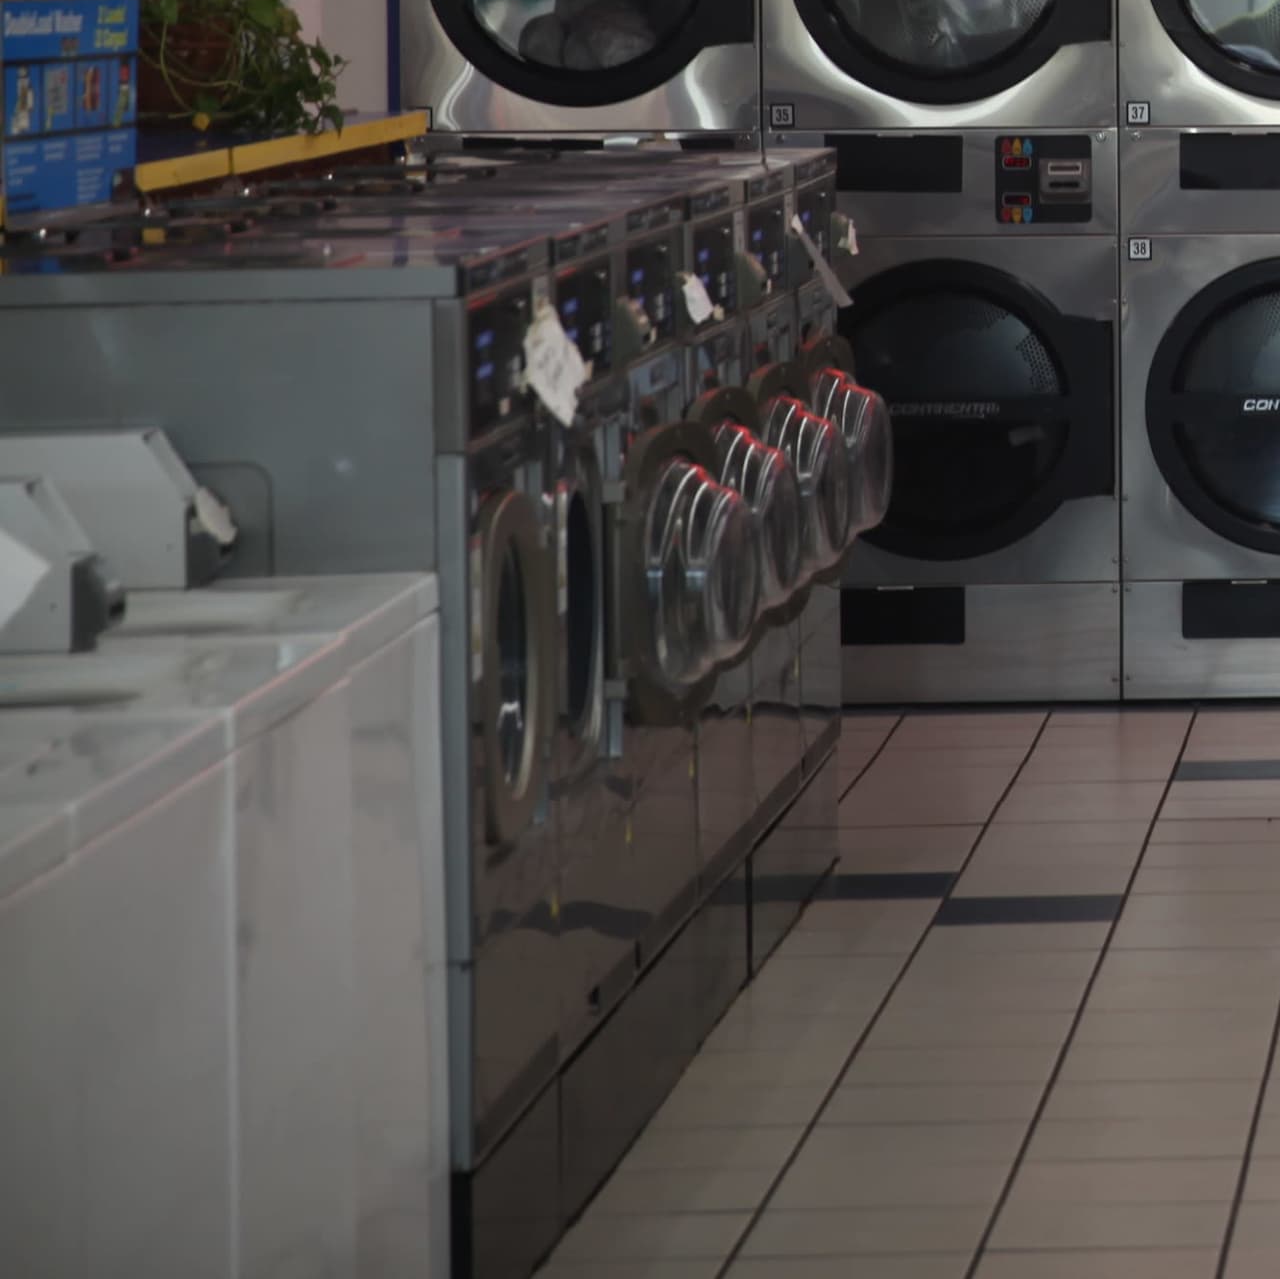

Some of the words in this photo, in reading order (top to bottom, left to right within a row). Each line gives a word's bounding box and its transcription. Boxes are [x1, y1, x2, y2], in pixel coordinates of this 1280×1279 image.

[775, 108, 789, 122] 35
[1131, 105, 1145, 120] 37
[1133, 242, 1146, 255] 38
